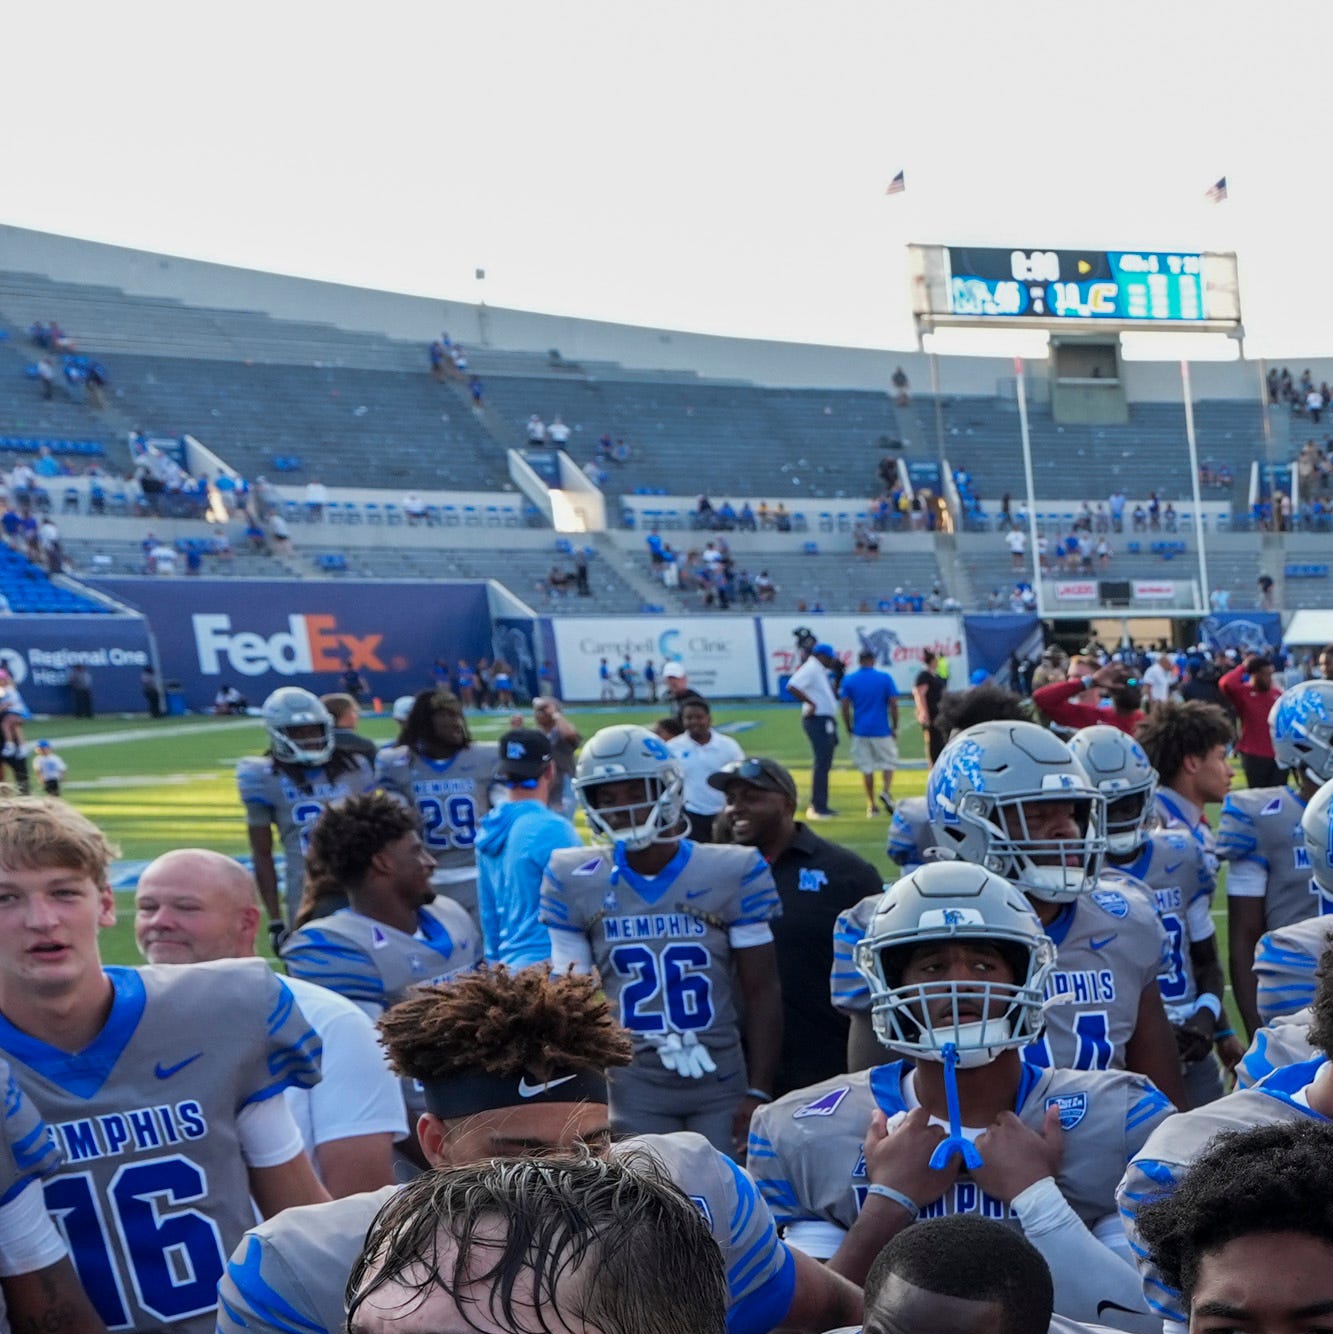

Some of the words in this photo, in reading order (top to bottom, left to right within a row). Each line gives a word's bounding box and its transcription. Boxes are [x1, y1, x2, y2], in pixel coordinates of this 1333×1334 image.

[30, 649, 107, 668] Regional
[112, 650, 147, 666] One
[192, 614, 387, 675] FedEx
[580, 636, 654, 658] Campbell
[688, 636, 730, 654] Clinic
[414, 794, 479, 850] 29
[605, 913, 706, 941] MEMPHIS
[609, 942, 716, 1036] 26
[44, 1152, 228, 1332] 16
